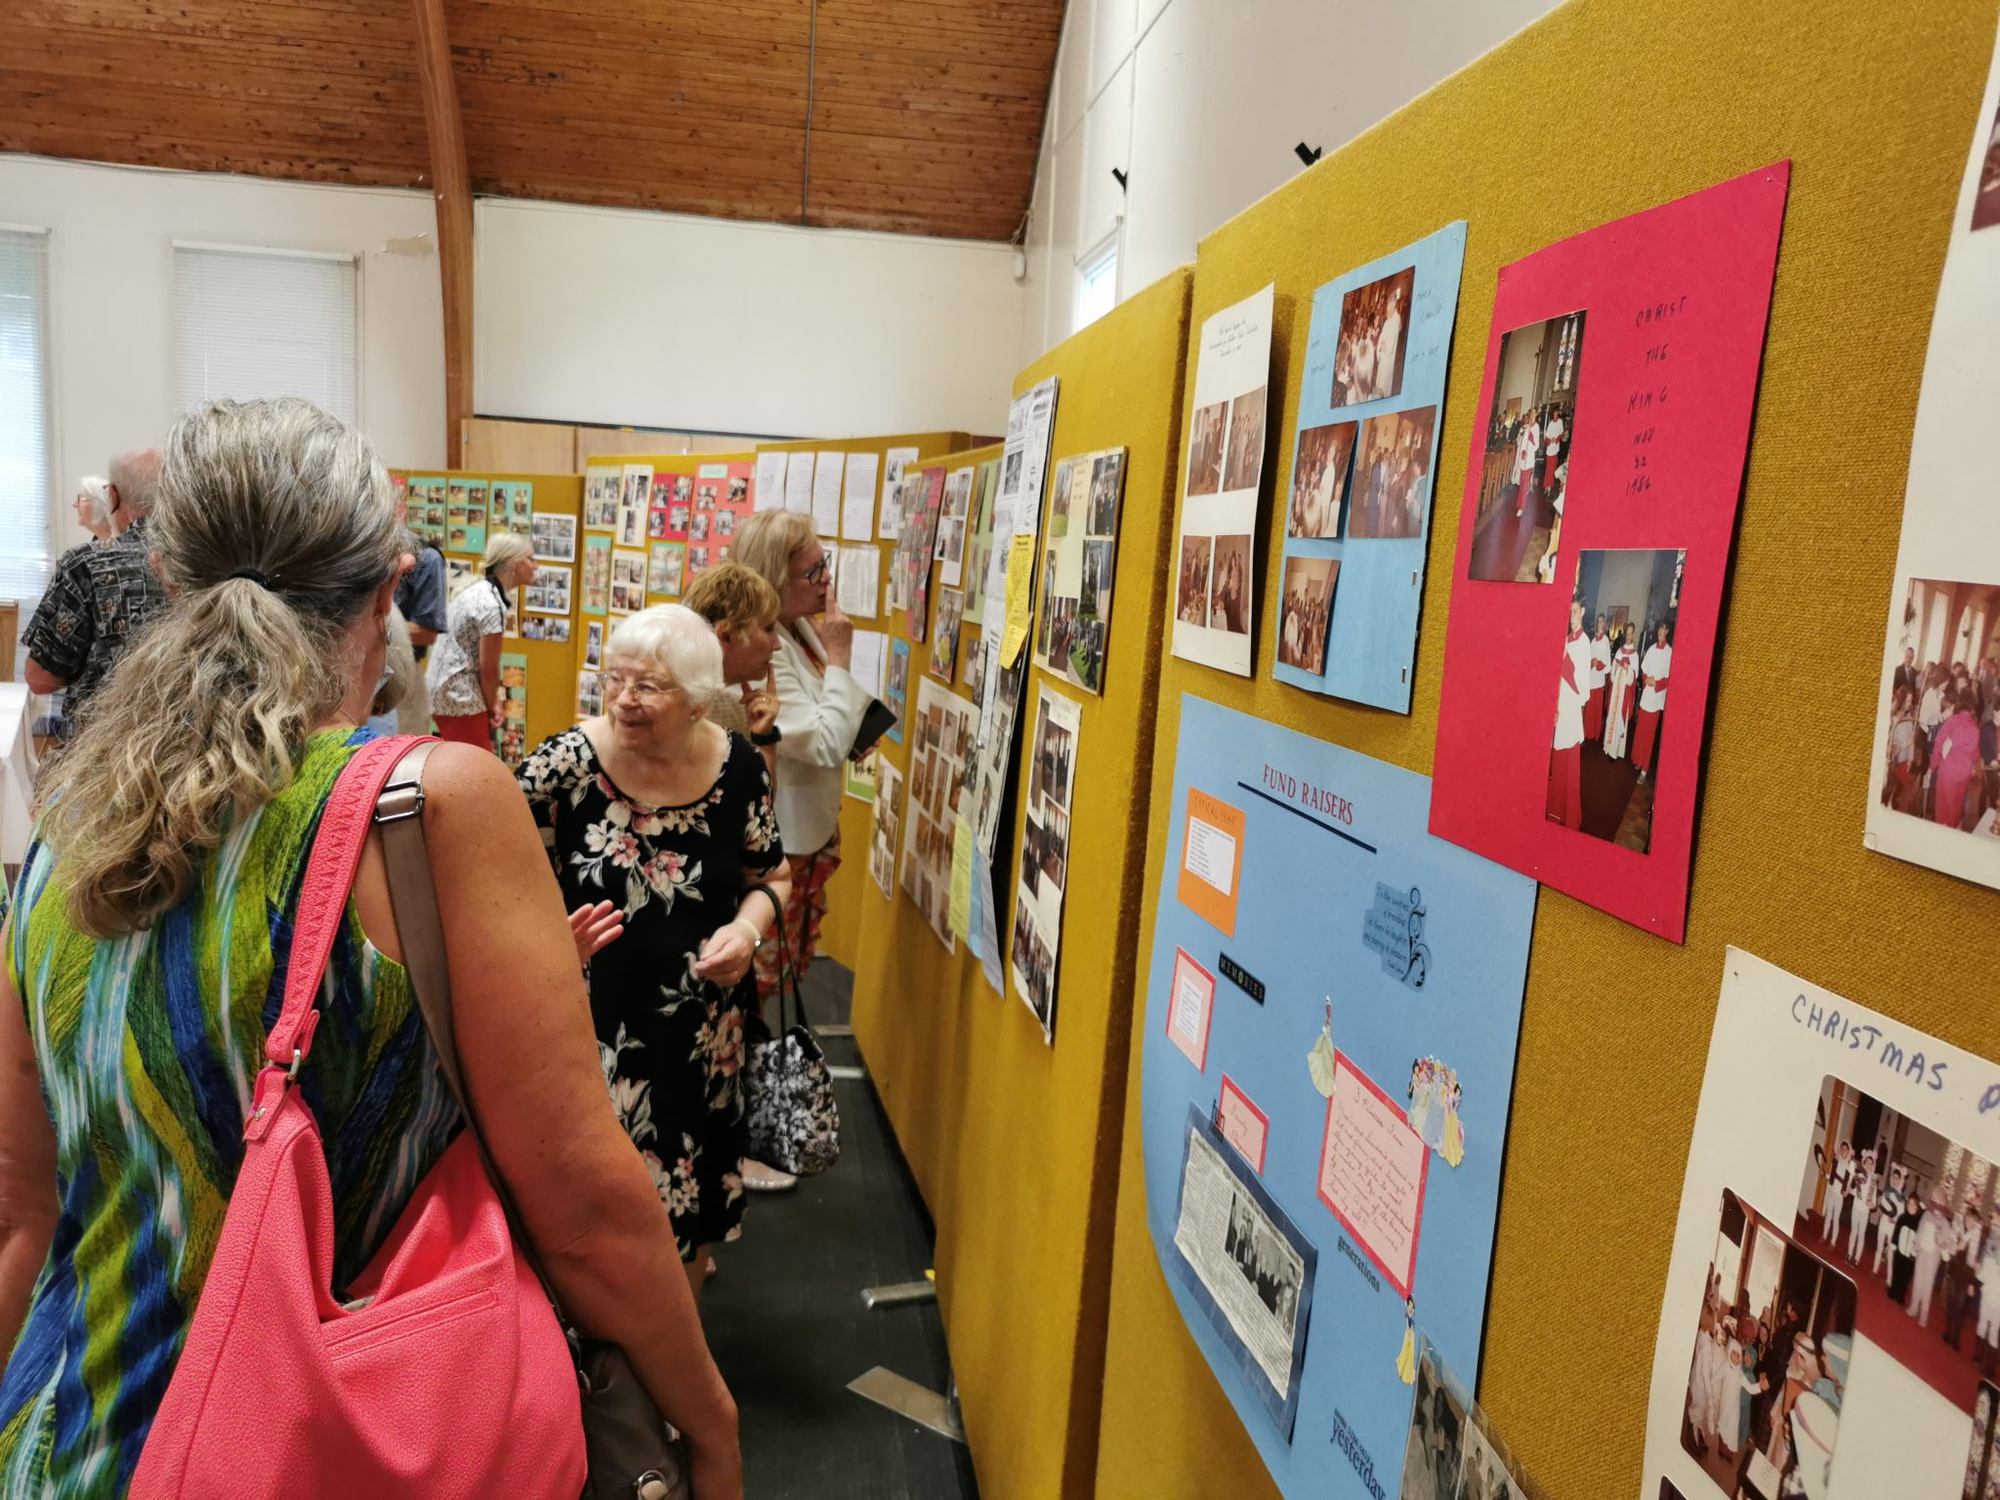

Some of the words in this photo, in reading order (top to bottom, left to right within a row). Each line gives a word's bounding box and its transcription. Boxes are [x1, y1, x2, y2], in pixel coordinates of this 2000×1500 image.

[1263, 763, 1298, 798] FUND
[1301, 781, 1355, 826] RAISERS
[1791, 993, 1948, 1091] CHRISTMAS
[1337, 1234, 1381, 1293] generations
